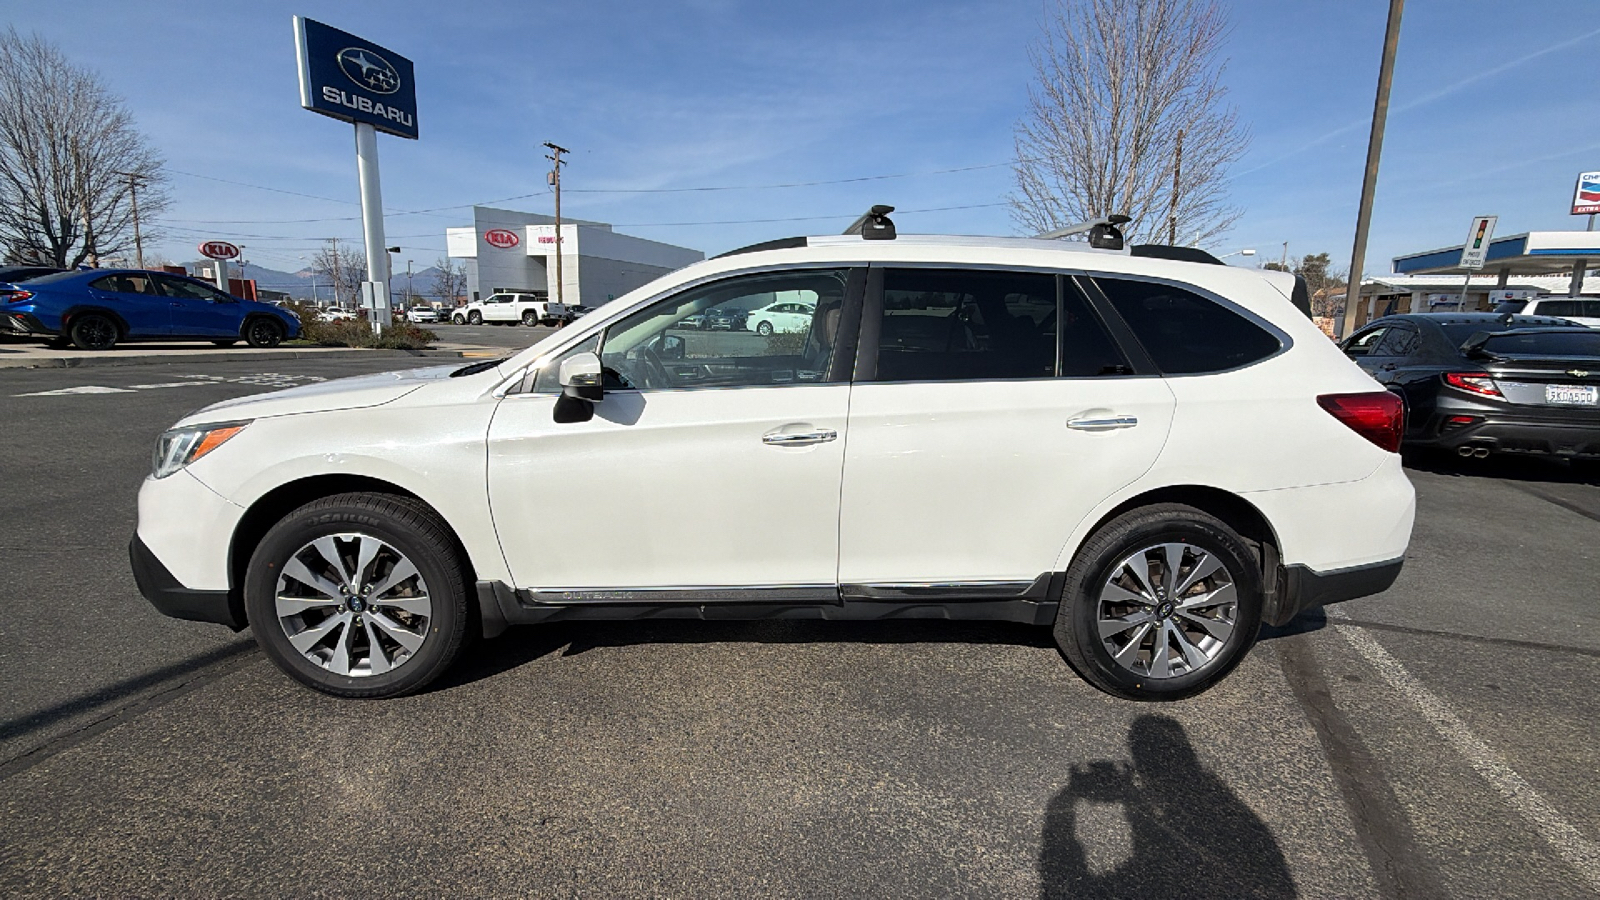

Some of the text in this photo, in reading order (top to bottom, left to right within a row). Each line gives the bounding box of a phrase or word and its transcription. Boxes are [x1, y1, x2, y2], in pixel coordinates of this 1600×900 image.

[322, 86, 413, 128] SUBARU
[491, 232, 514, 245] KIA
[208, 244, 234, 256] KIA
[562, 591, 634, 599] OUTBACK
